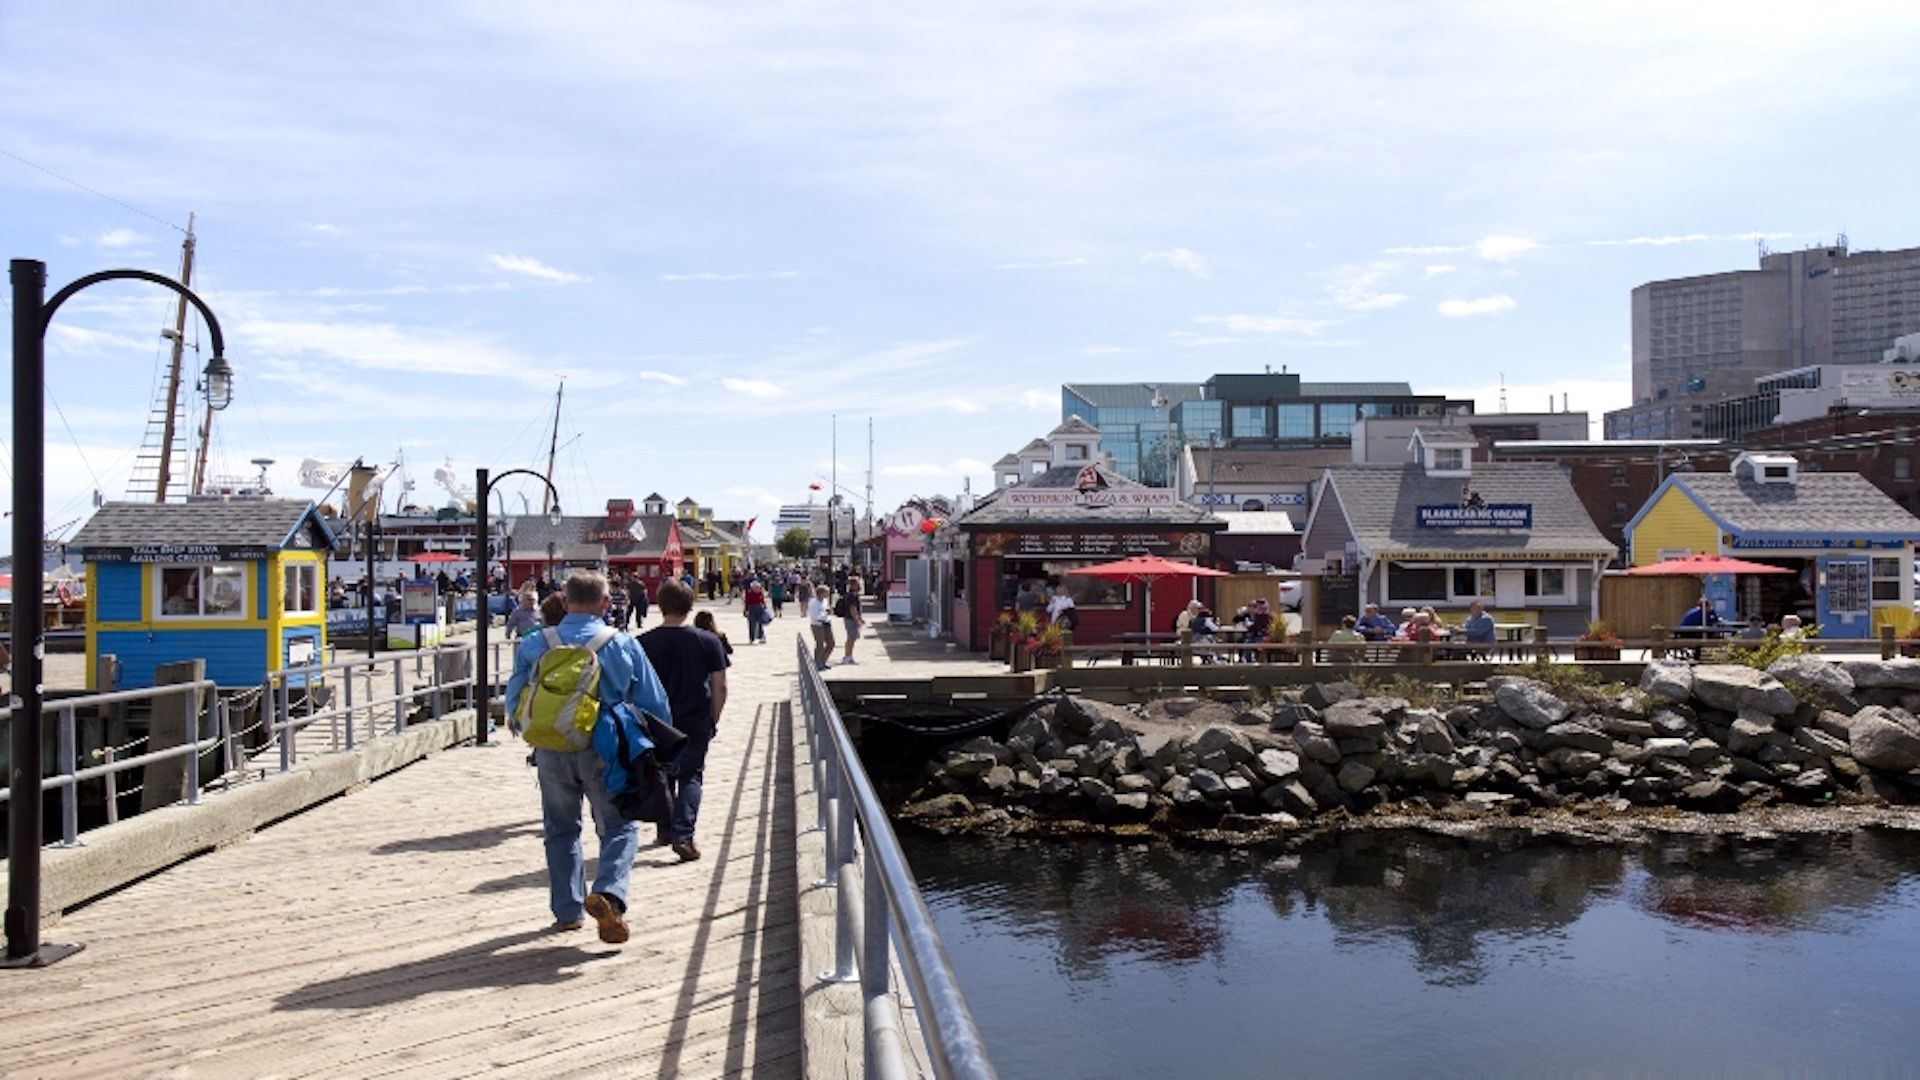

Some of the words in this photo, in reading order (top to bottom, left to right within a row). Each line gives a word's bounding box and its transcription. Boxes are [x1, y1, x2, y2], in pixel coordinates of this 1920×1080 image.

[1084, 493, 1116, 504] PIZZA
[1132, 493, 1170, 503] WRAPS
[1421, 508, 1452, 520] BLACK
[1493, 508, 1528, 520] CREAM
[131, 545, 158, 554] TALL
[130, 554, 174, 563] SAILING
[176, 553, 222, 562] CRUISES
